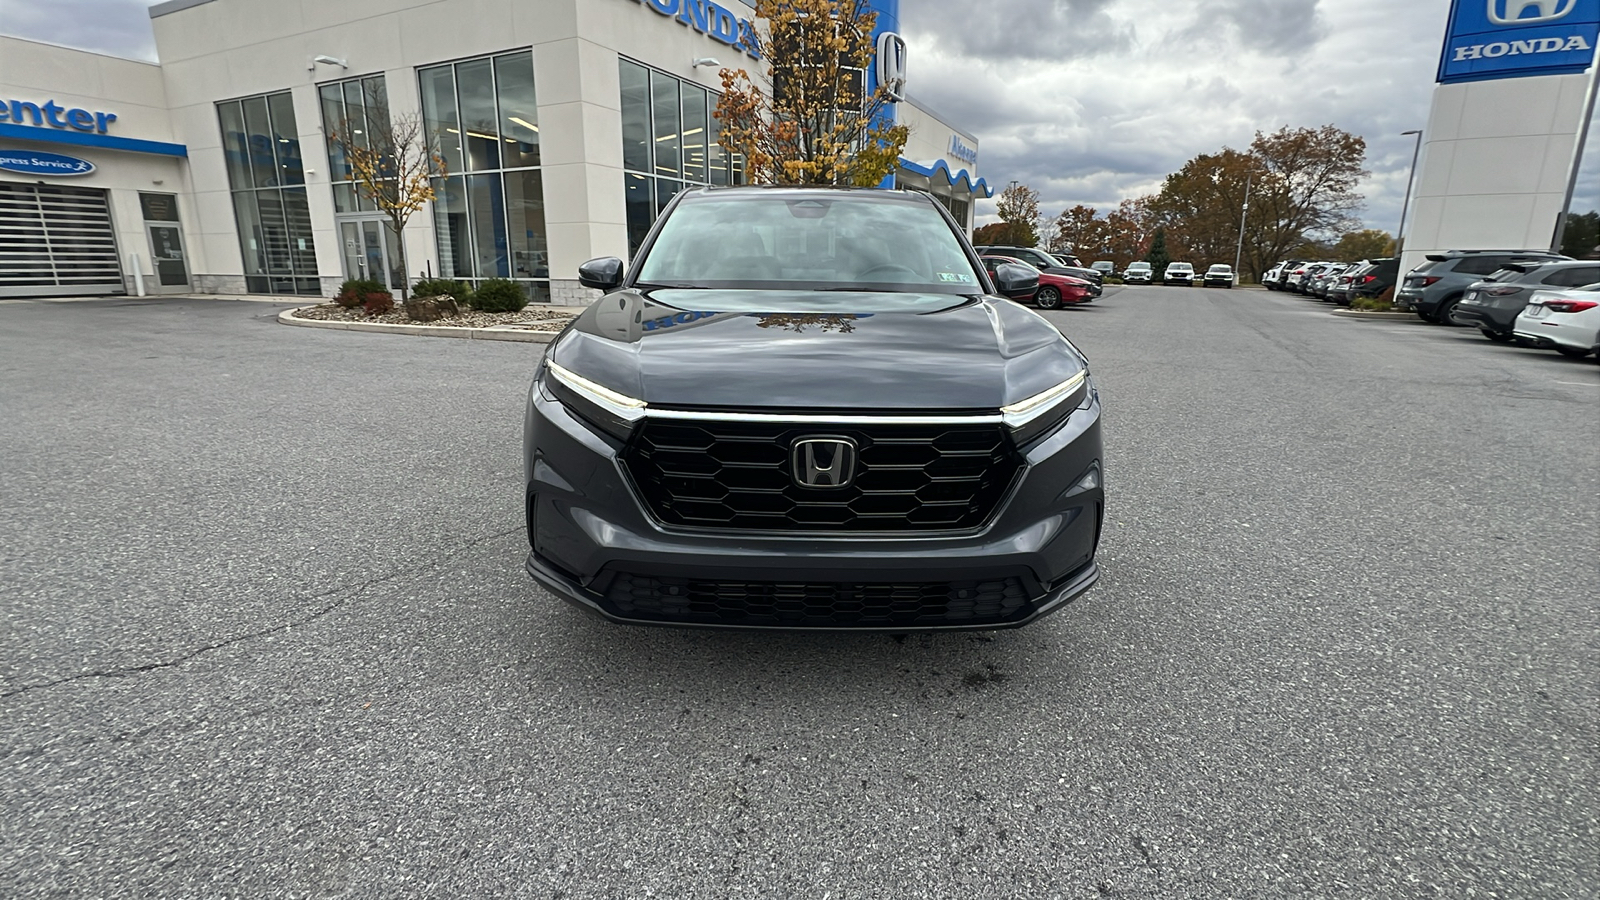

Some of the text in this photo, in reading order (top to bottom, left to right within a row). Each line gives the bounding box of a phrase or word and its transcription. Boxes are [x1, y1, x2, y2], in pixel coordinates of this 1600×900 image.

[640, 0, 763, 60] ONDA
[1452, 36, 1591, 62] HONDA
[31, 157, 73, 169] Service
